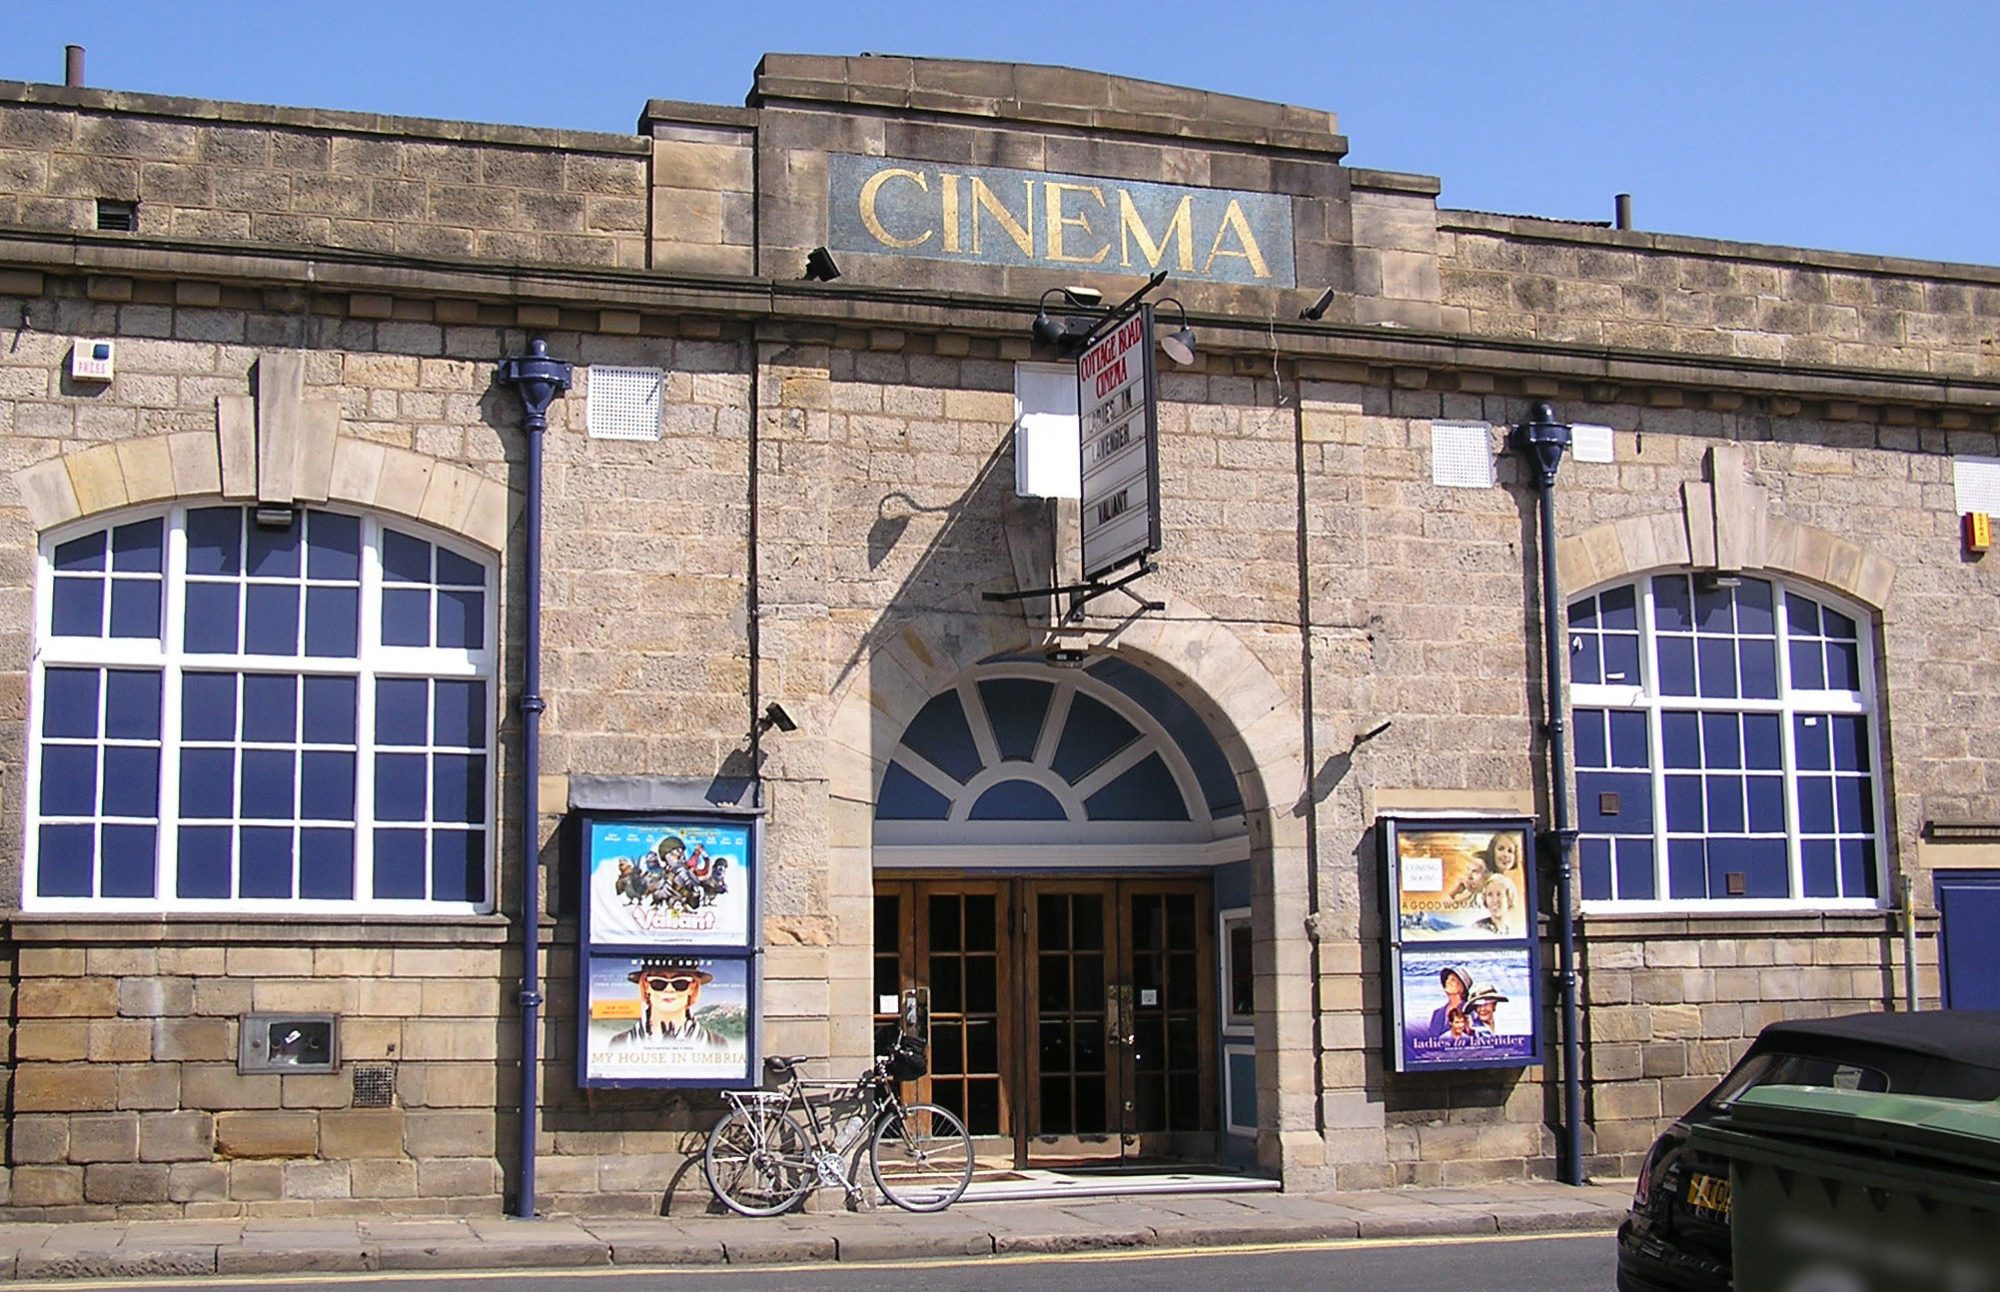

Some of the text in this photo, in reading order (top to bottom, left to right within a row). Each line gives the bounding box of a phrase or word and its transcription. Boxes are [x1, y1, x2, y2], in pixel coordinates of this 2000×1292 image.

[859, 168, 1273, 278] CINEMA
[1081, 317, 1142, 382] COTTAGE ROAD
[1096, 356, 1127, 399] CINEMA
[632, 905, 716, 930] Valiant
[1402, 900, 1482, 910] A GOOD WOMAN
[1413, 1036, 1451, 1049] ladies
[1469, 1035, 1525, 1047] lavender
[591, 1052, 747, 1064] MY HOUSE IN UMBRIA
